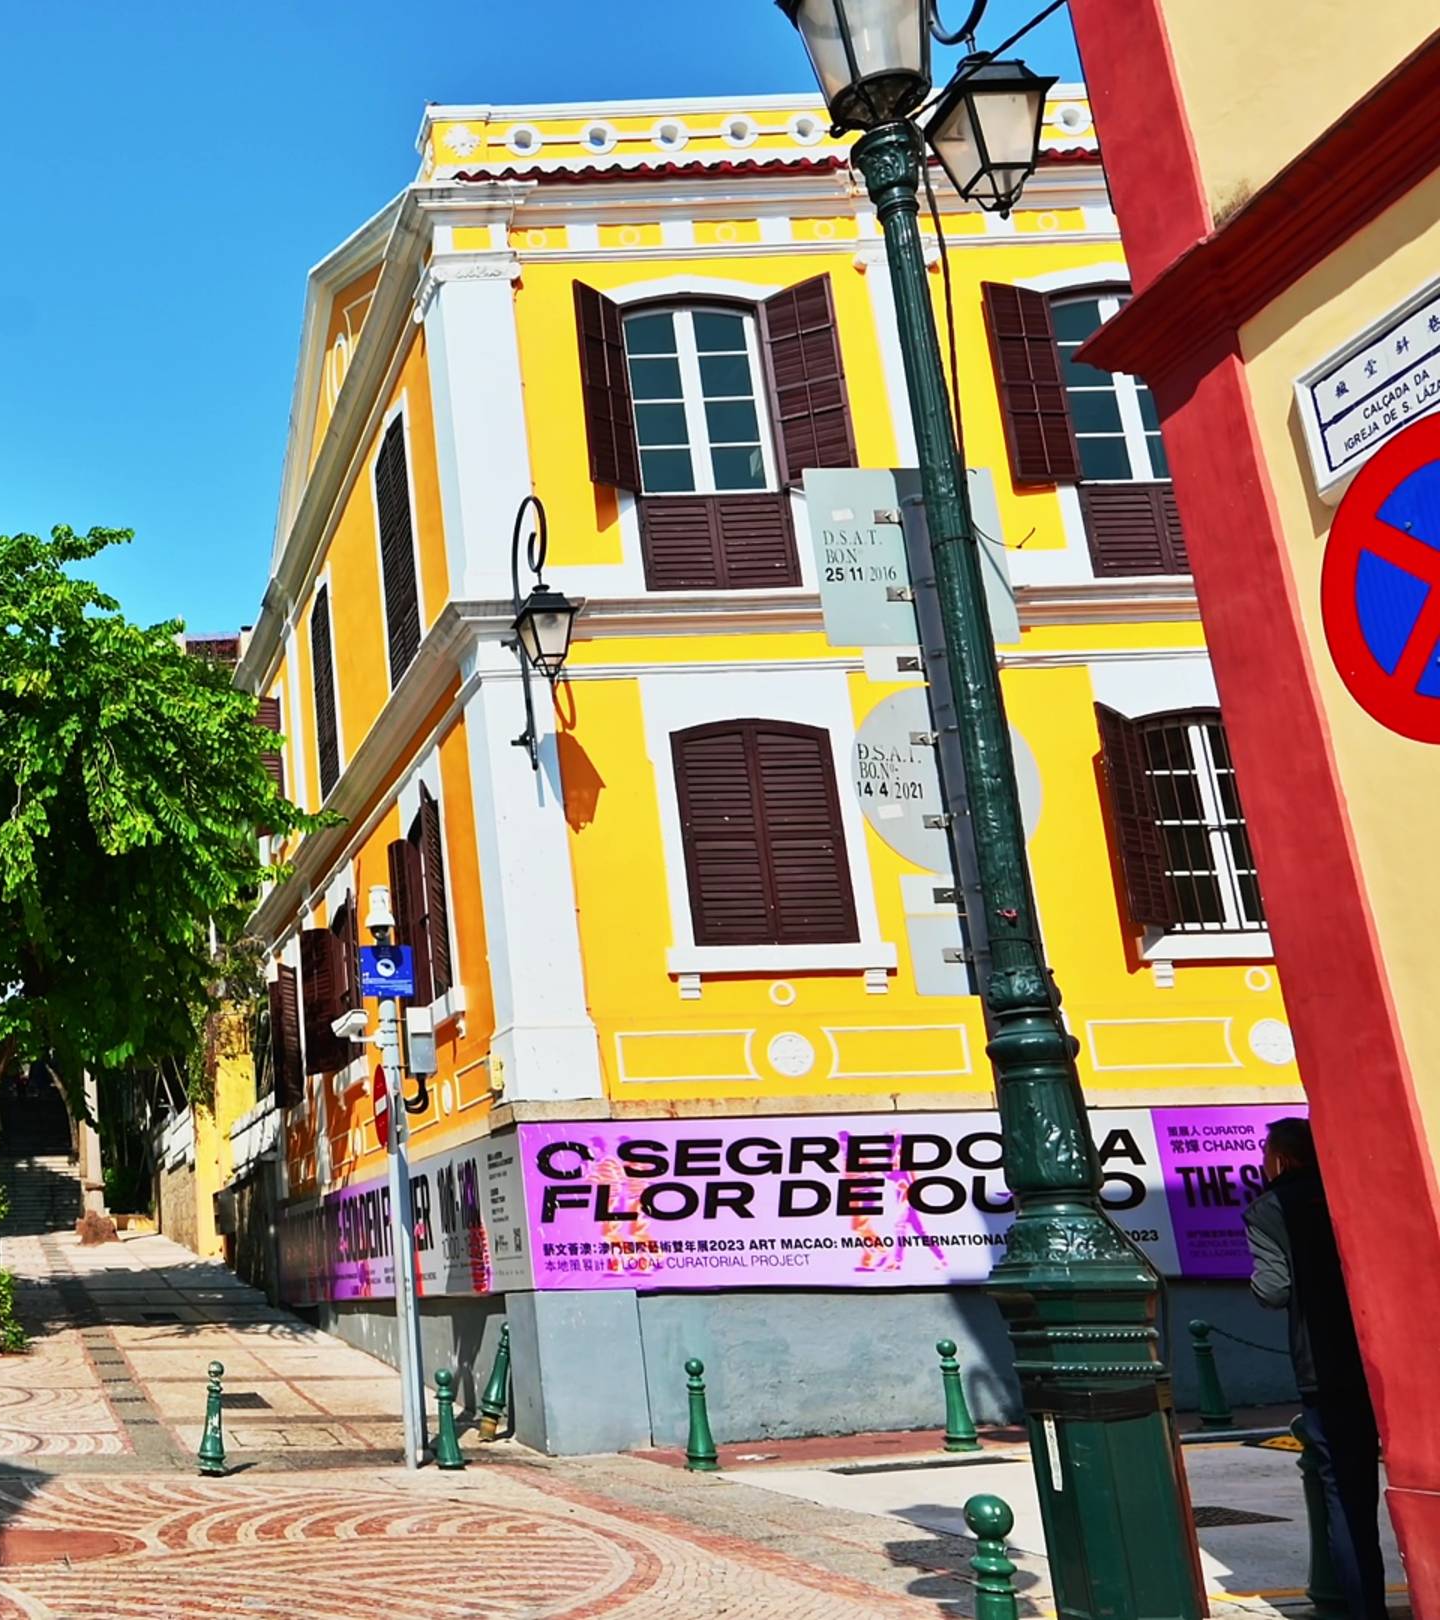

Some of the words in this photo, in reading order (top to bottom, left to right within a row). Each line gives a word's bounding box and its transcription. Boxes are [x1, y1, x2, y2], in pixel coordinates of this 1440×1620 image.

[1362, 382, 1410, 420] CALÇADA
[1413, 369, 1430, 386] DA
[1343, 421, 1379, 451] IGREJA
[1382, 408, 1398, 425] DE
[1202, 1125, 1255, 1136] CURATOR
[1202, 1139, 1256, 1152] CHANG
[617, 1132, 1004, 1178] SEGREDO
[540, 1181, 755, 1223] FLOR
[778, 1178, 885, 1217] DE
[906, 1171, 1147, 1215] OUO
[1174, 1164, 1241, 1208] THE
[622, 1257, 664, 1272] LOCAL
[666, 1256, 748, 1269] CURATORIAL
[751, 1254, 810, 1267] PROJECT
[749, 1239, 776, 1250] ART
[781, 1237, 838, 1250] MACAO:
[841, 1236, 894, 1248] MACAO
